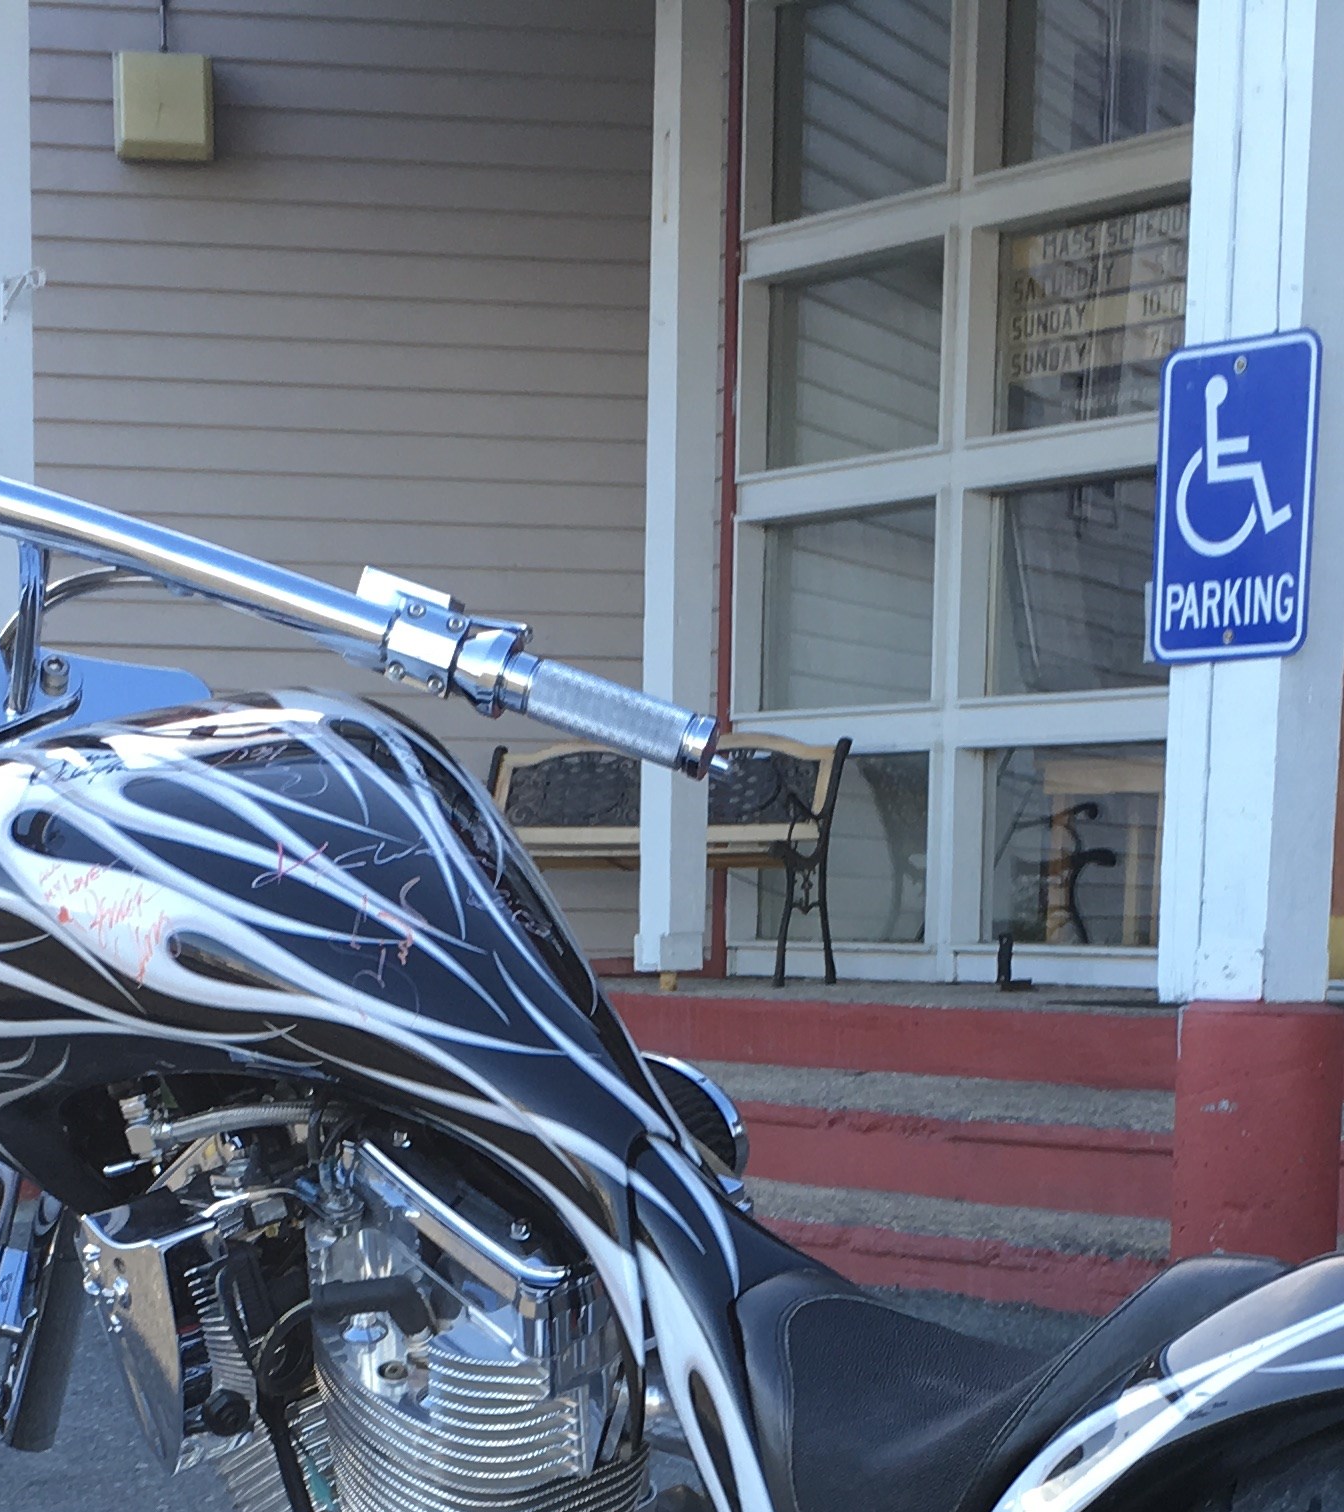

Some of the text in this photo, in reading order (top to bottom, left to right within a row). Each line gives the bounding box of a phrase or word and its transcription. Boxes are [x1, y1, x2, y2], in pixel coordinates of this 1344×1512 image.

[1042, 205, 1189, 260] MASS SCHEDU
[1012, 286, 1182, 341] SUNDAY 10:0
[1011, 342, 1087, 378] SUNDAY
[1164, 572, 1295, 632] PARKING
